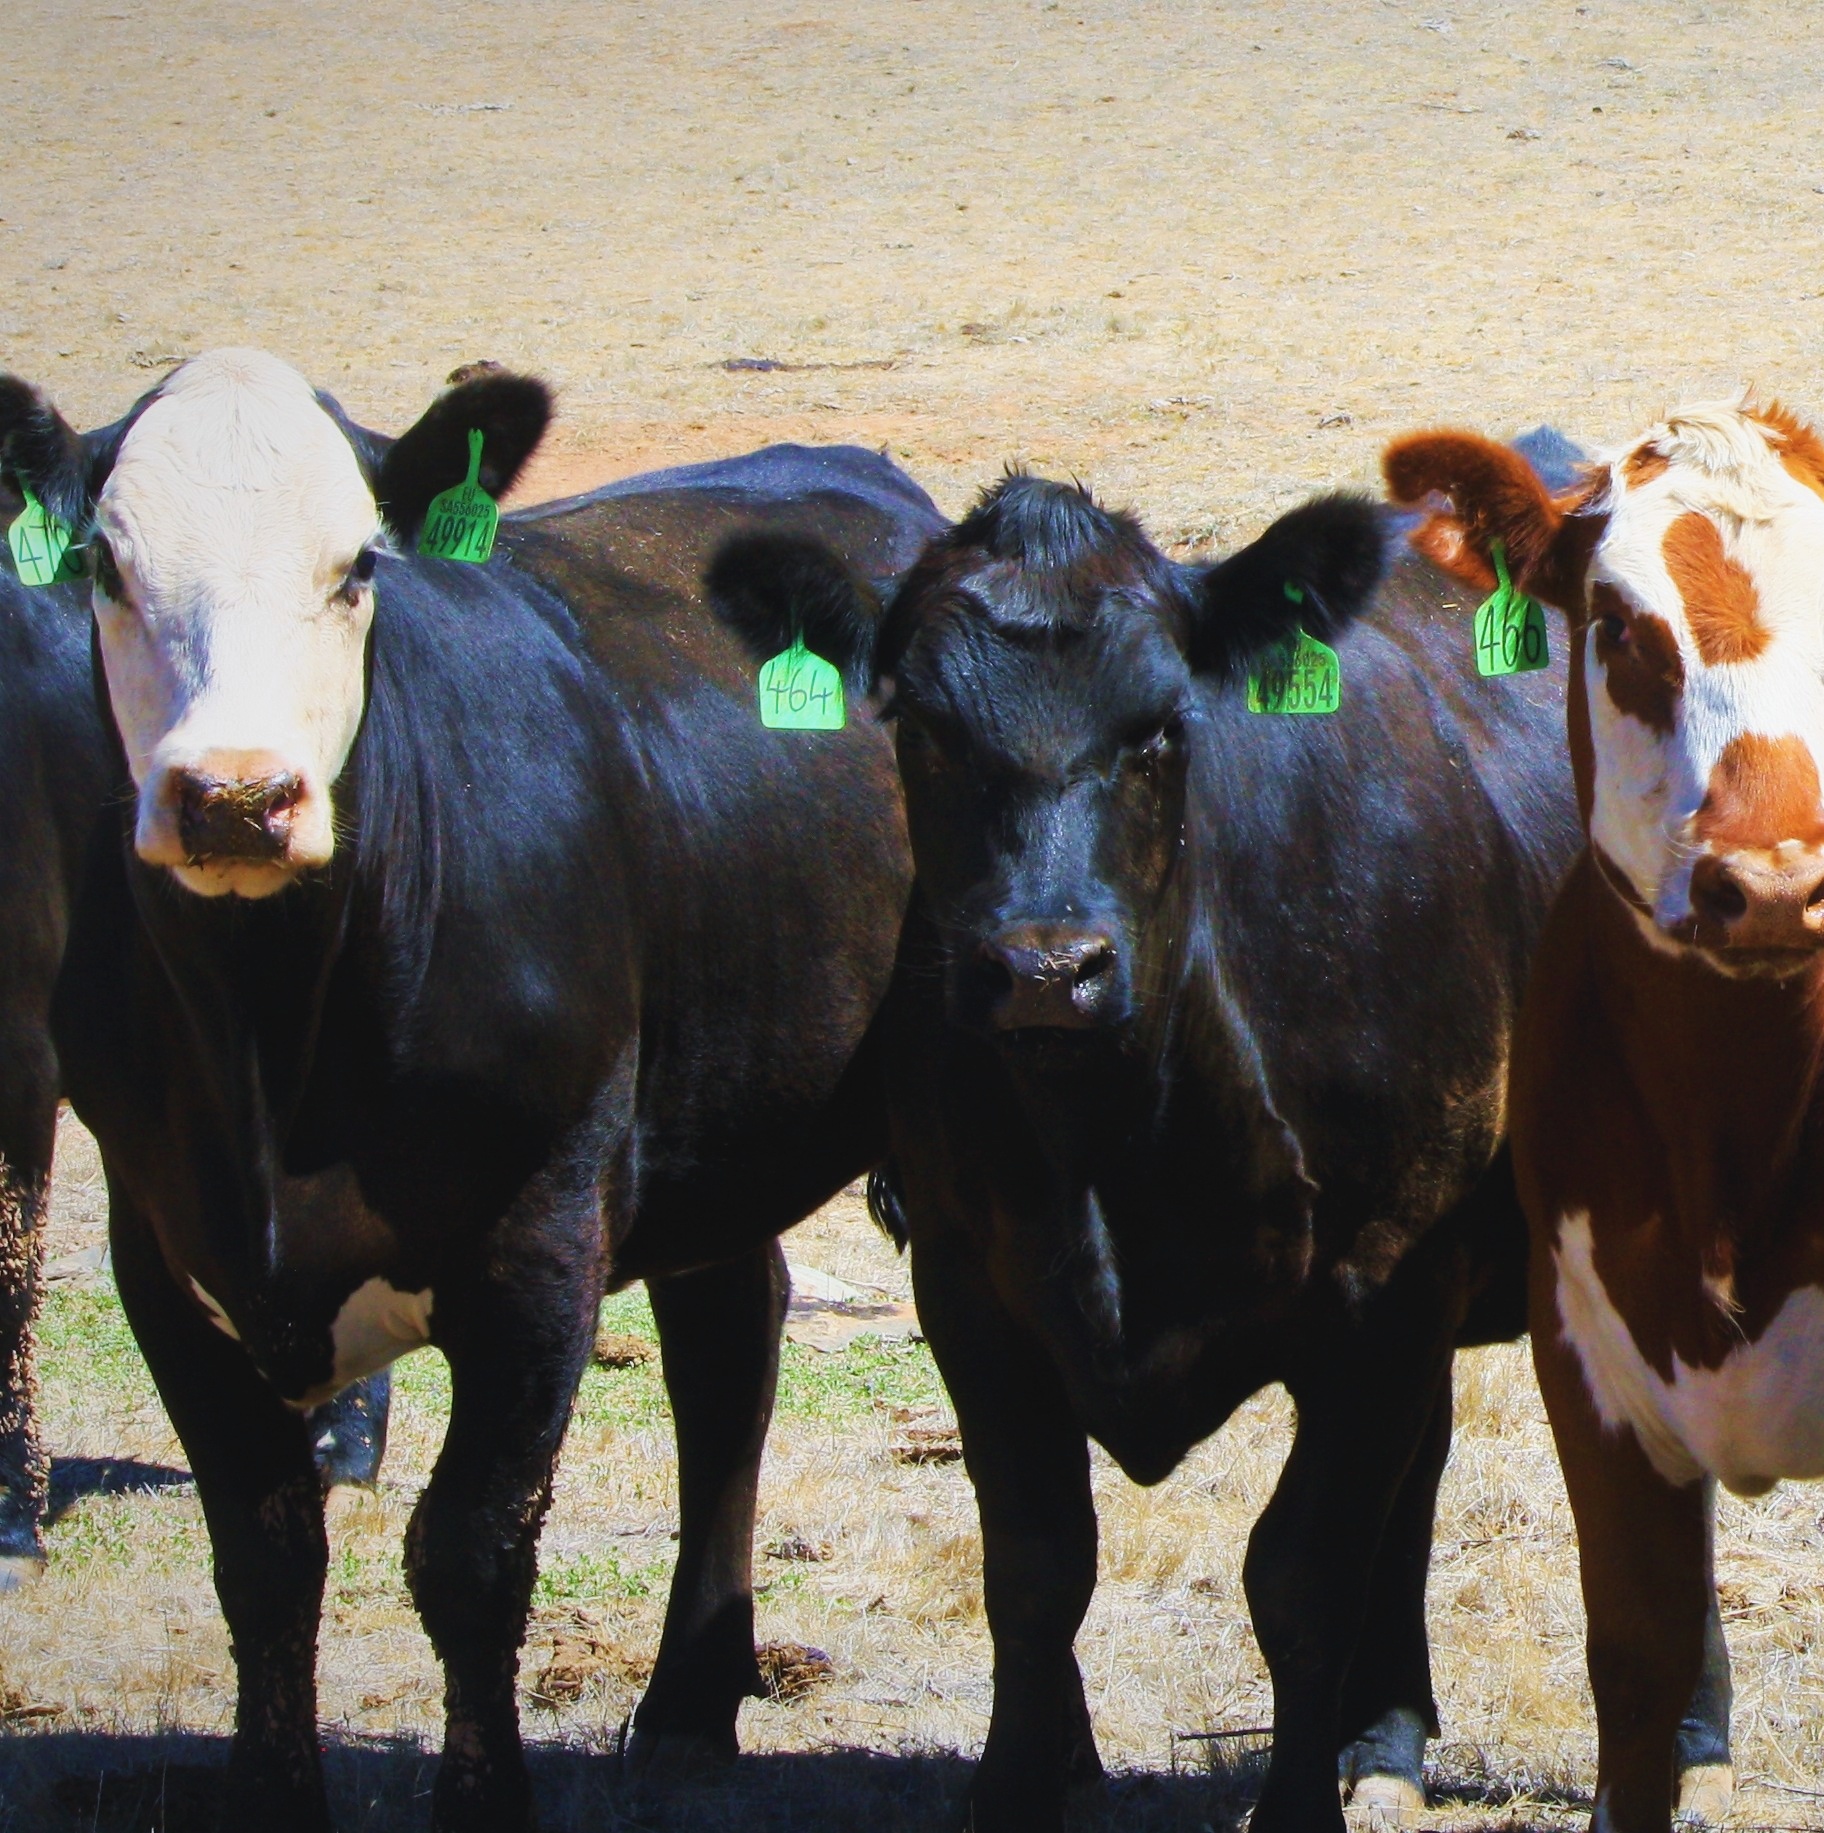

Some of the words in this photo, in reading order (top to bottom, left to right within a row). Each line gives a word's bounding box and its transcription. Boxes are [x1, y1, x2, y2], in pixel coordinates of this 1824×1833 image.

[426, 513, 491, 559] 49914
[1479, 599, 1541, 673] 466
[766, 660, 834, 716] 464
